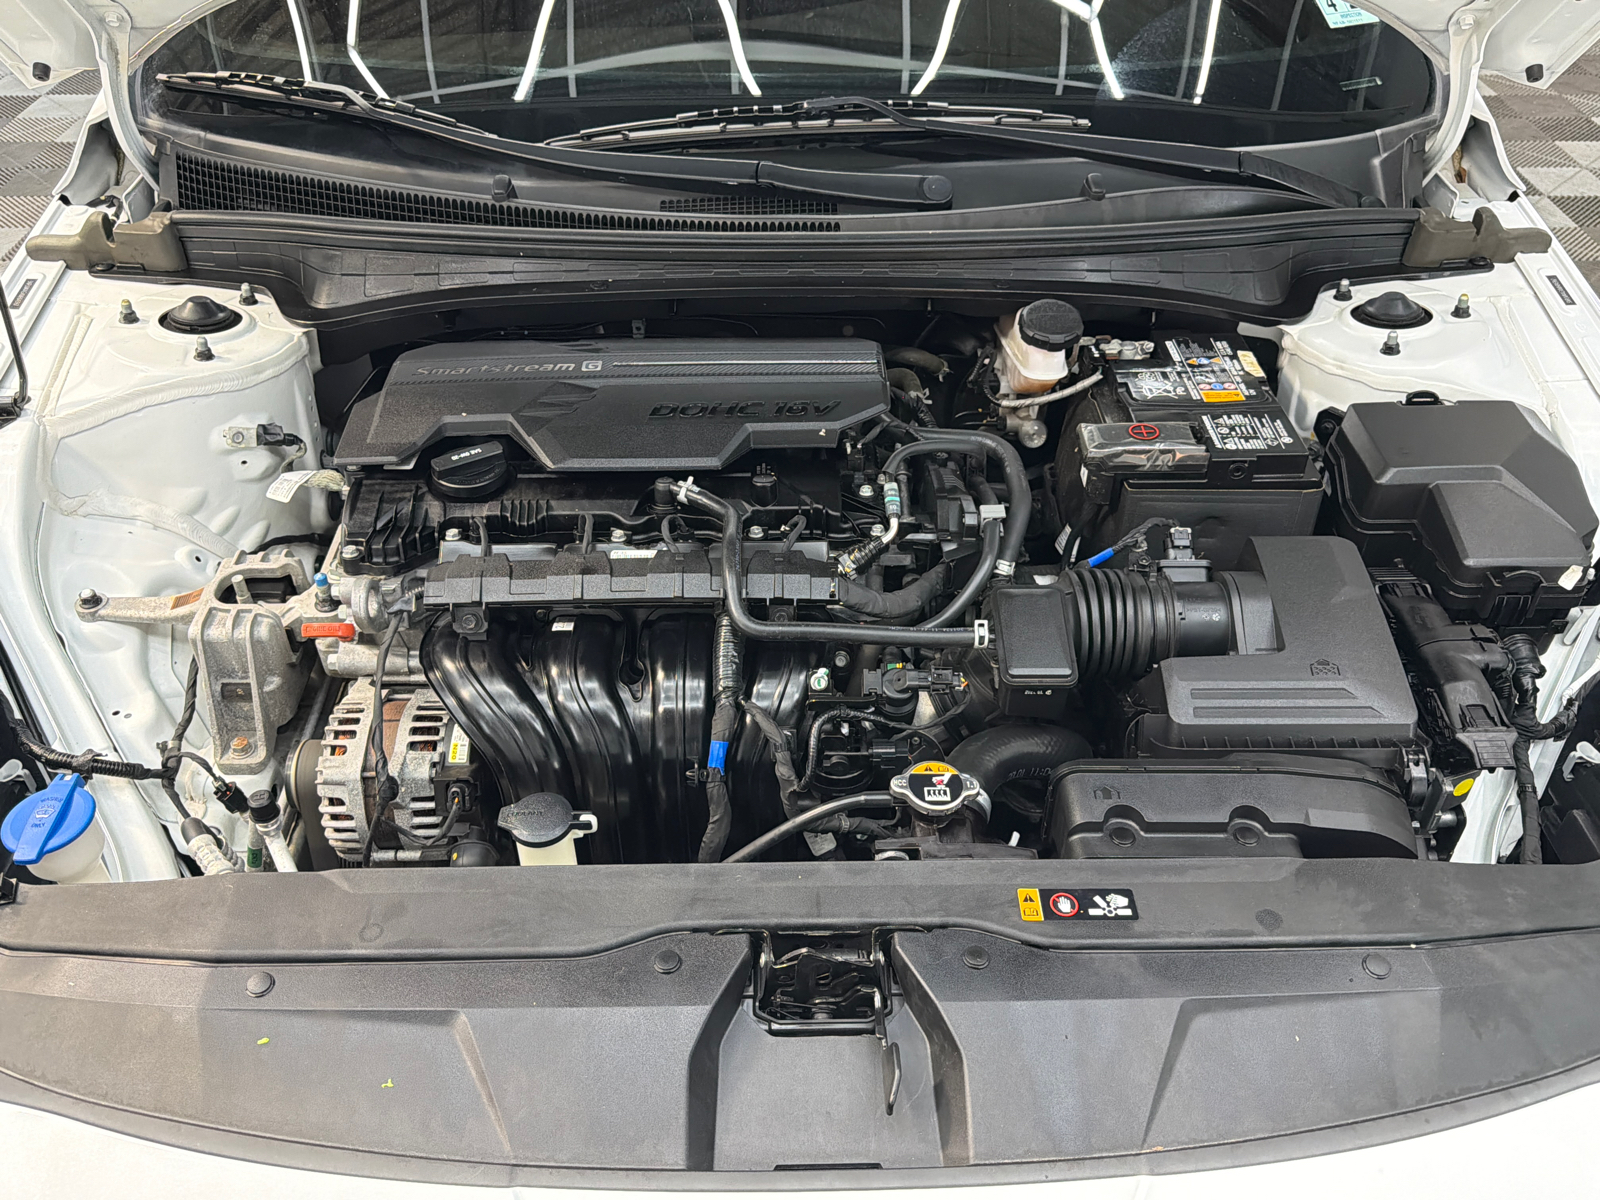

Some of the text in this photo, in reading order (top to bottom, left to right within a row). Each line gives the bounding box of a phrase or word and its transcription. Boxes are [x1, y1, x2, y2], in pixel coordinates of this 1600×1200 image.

[412, 363, 576, 376] Smartstream
[648, 400, 841, 418] DOHC 16V
[893, 779, 977, 789] HCC 1.1
